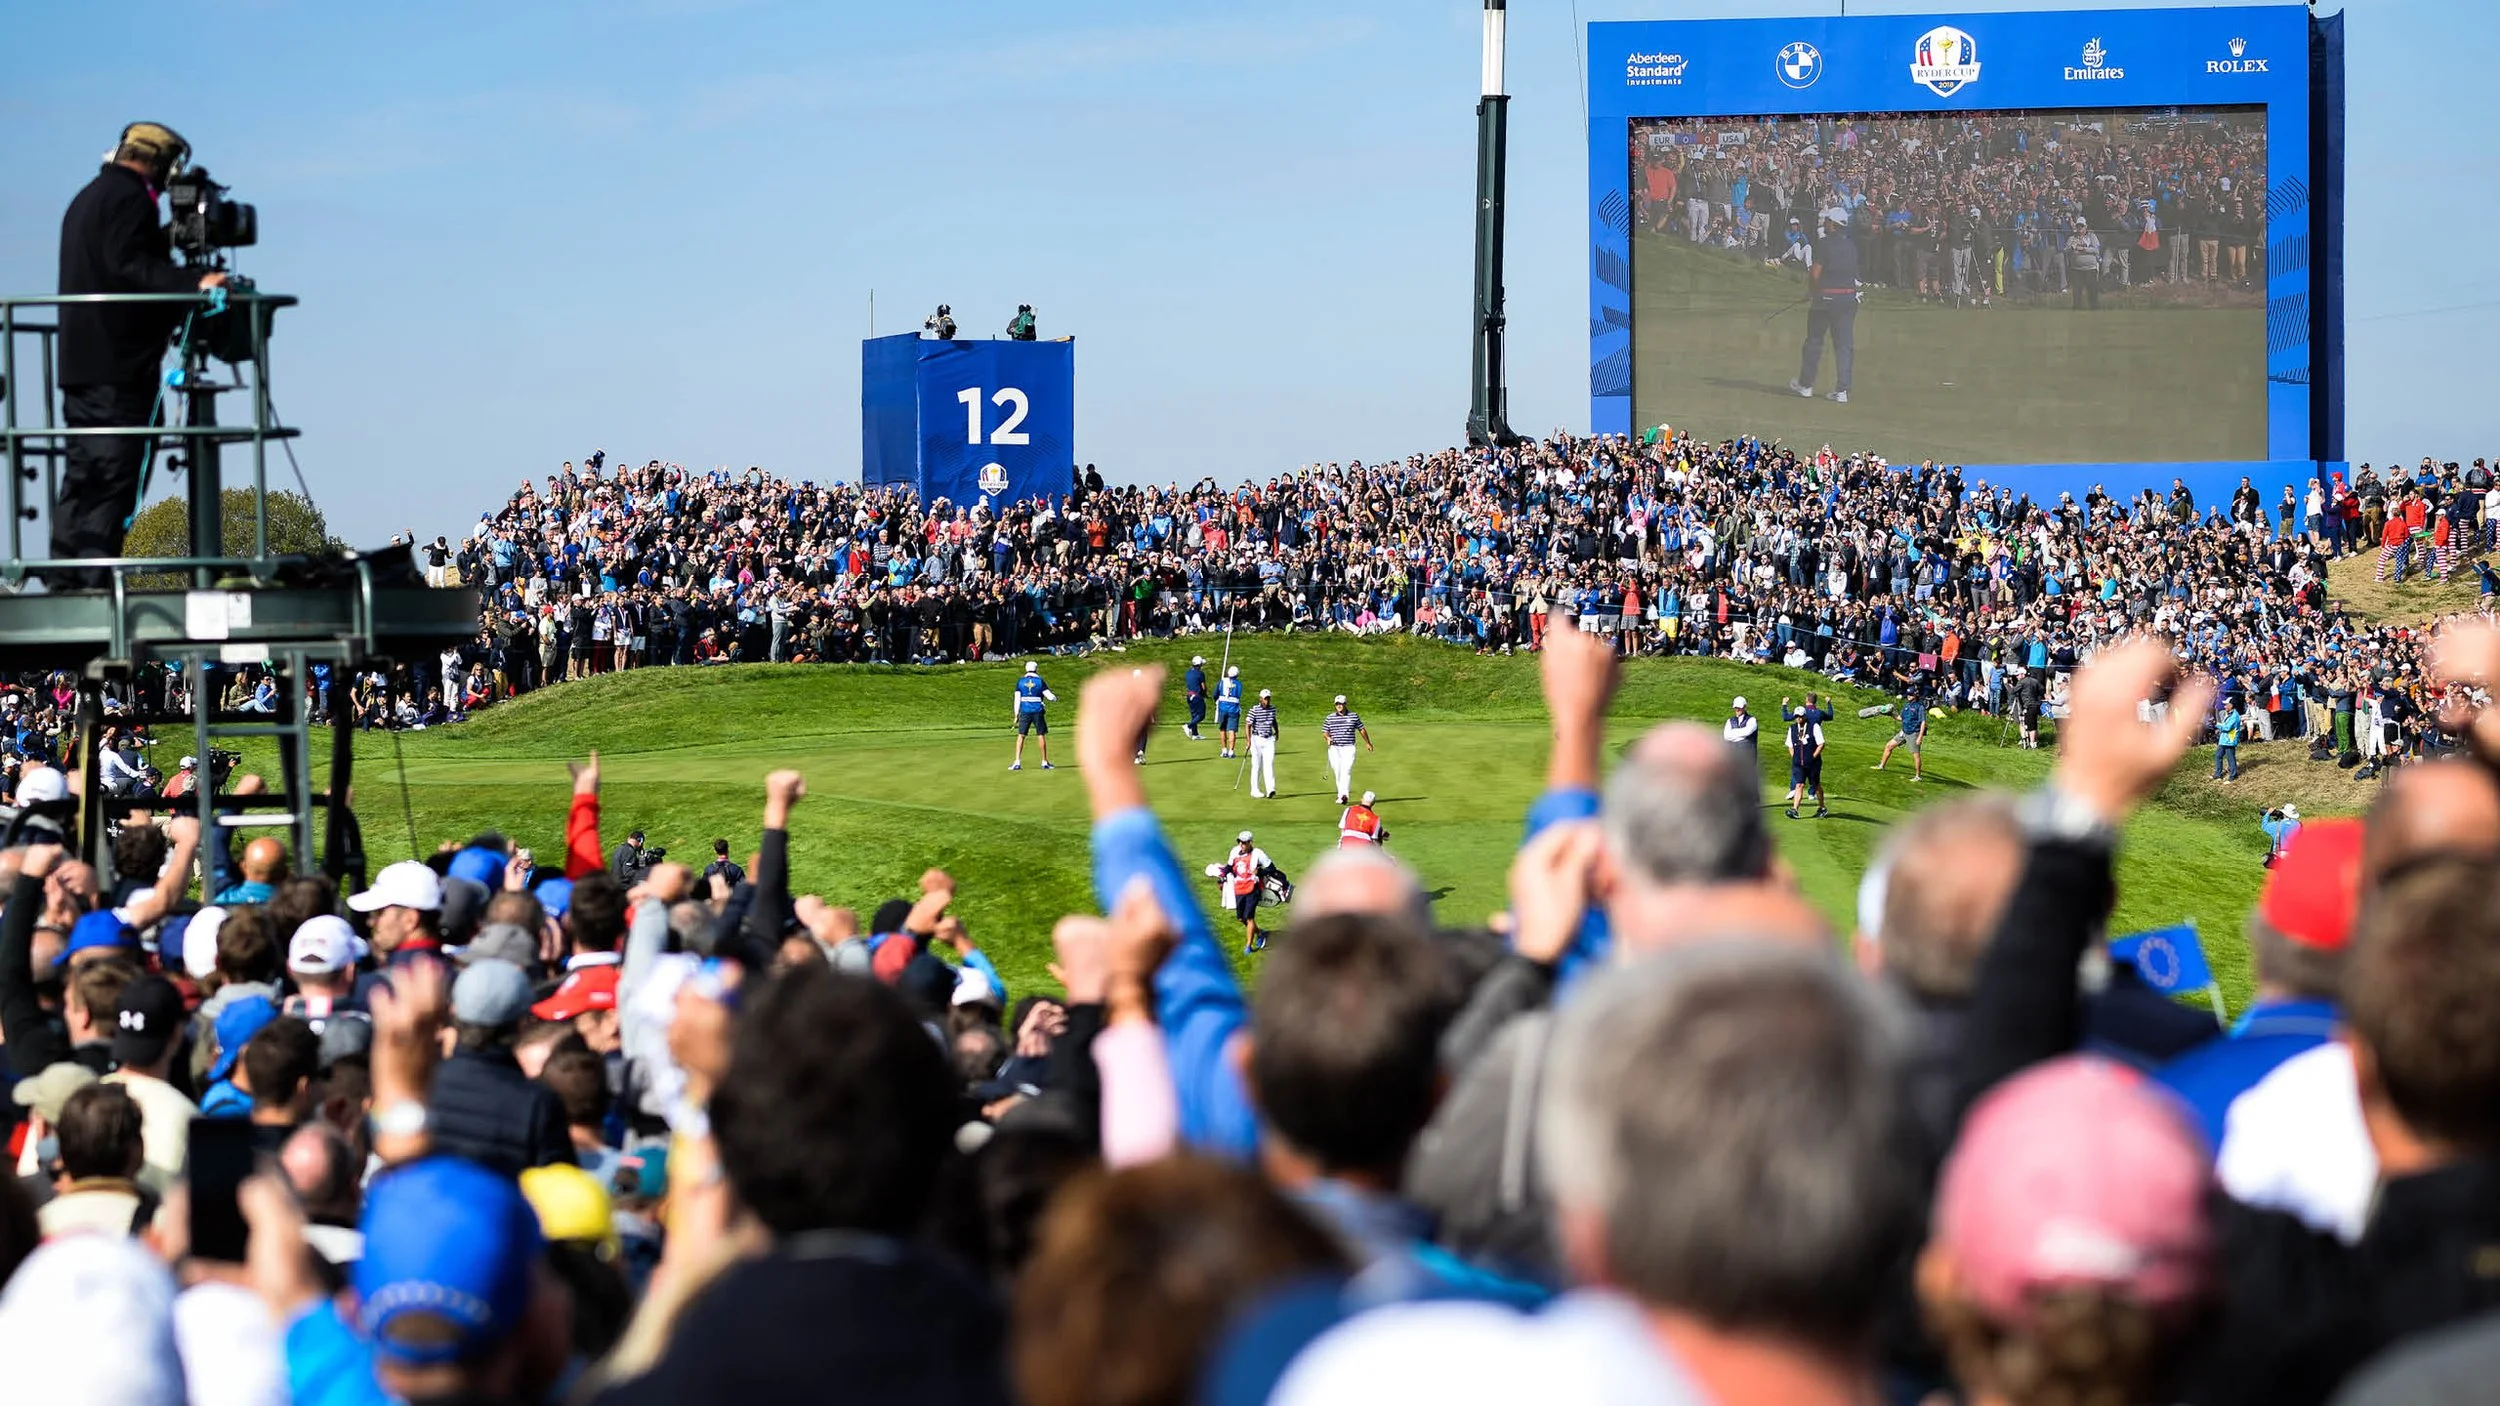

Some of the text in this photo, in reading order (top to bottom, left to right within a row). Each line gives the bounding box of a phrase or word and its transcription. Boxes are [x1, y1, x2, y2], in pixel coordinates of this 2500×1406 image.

[1780, 43, 1818, 59] BMW
[1627, 52, 1682, 64] Aberdeen
[1627, 65, 1682, 77] Standard
[2205, 59, 2269, 73] ROLEX
[1917, 67, 1974, 78] RYDER CUP
[2064, 67, 2124, 80] Emirates
[1654, 135, 1740, 145] EUR 0 0 USA
[957, 387, 1030, 445] 12
